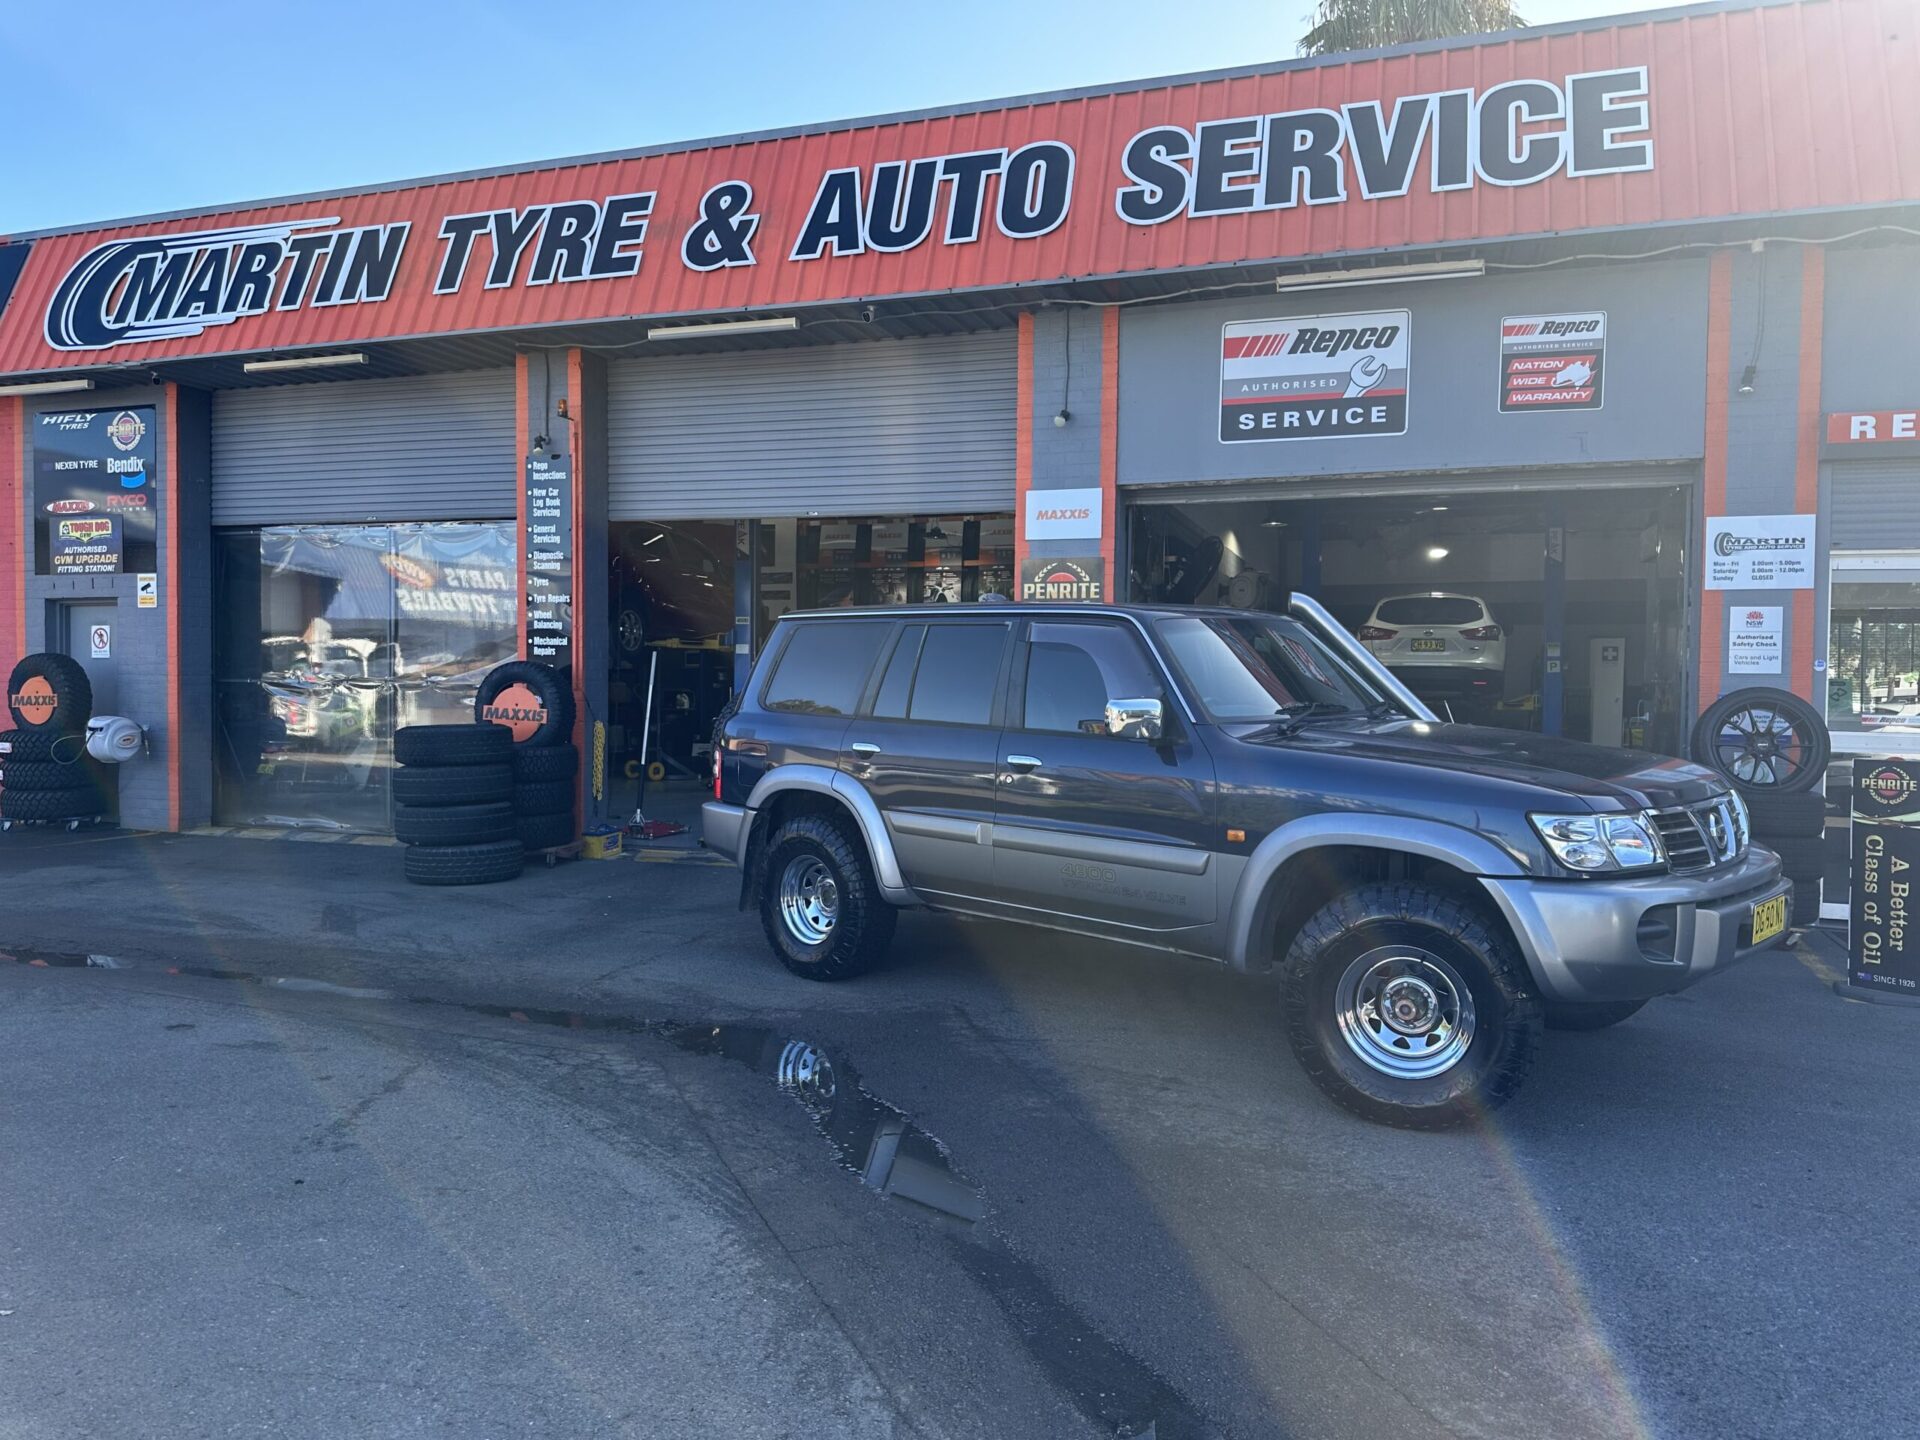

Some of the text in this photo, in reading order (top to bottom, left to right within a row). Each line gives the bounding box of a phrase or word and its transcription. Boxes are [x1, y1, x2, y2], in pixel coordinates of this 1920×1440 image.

[104, 65, 1654, 327] MARTIN TYRE & AUTO SERVICE
[1539, 320, 1600, 336] Repco
[1288, 326, 1400, 357] Repco
[1512, 360, 1565, 370] NATION
[1241, 378, 1338, 392] AUTHORISED
[1513, 377, 1547, 385] WIDE
[1512, 391, 1590, 401] WARRANTY
[42, 413, 97, 425] HIFLY
[1238, 406, 1387, 430] SERVICE
[60, 422, 90, 431] TYRES
[107, 423, 146, 437] PENRITE
[55, 460, 98, 470] NEXEN TYRE
[107, 456, 144, 473] Bendix
[533, 461, 548, 471] Rego
[533, 471, 566, 481] Inspections
[533, 488, 559, 497] New Car
[107, 494, 147, 506] RYCO
[533, 498, 560, 507] Log Book
[533, 508, 560, 518] Servicing
[1036, 508, 1090, 520] MAXXIS
[69, 521, 110, 533] TOUGH DOG
[533, 524, 556, 533] General
[533, 534, 560, 544] Servicing
[1725, 537, 1806, 545] MARTIN
[64, 545, 108, 554] AUTHORISED
[54, 554, 118, 565] GVM UPGRADE
[533, 551, 564, 561] Diagnostic
[57, 564, 115, 573] FITTING STATION!
[533, 561, 561, 570] Scanning
[533, 577, 549, 587] Tyres
[1023, 582, 1100, 599] PENRITE
[533, 593, 570, 603] Tyre Repairs
[533, 610, 552, 619] Wheel
[533, 620, 562, 630] Balancing
[533, 636, 568, 646] Mechanical
[533, 646, 556, 656] Repairs
[13, 694, 57, 706] MAXXIS
[484, 706, 545, 722] MAXXIS
[1861, 777, 1918, 791] PENRITE
[1863, 834, 1884, 965] Class of Oil
[1889, 855, 1910, 952] A Better
[1873, 974, 1916, 988] SINCE 1926
